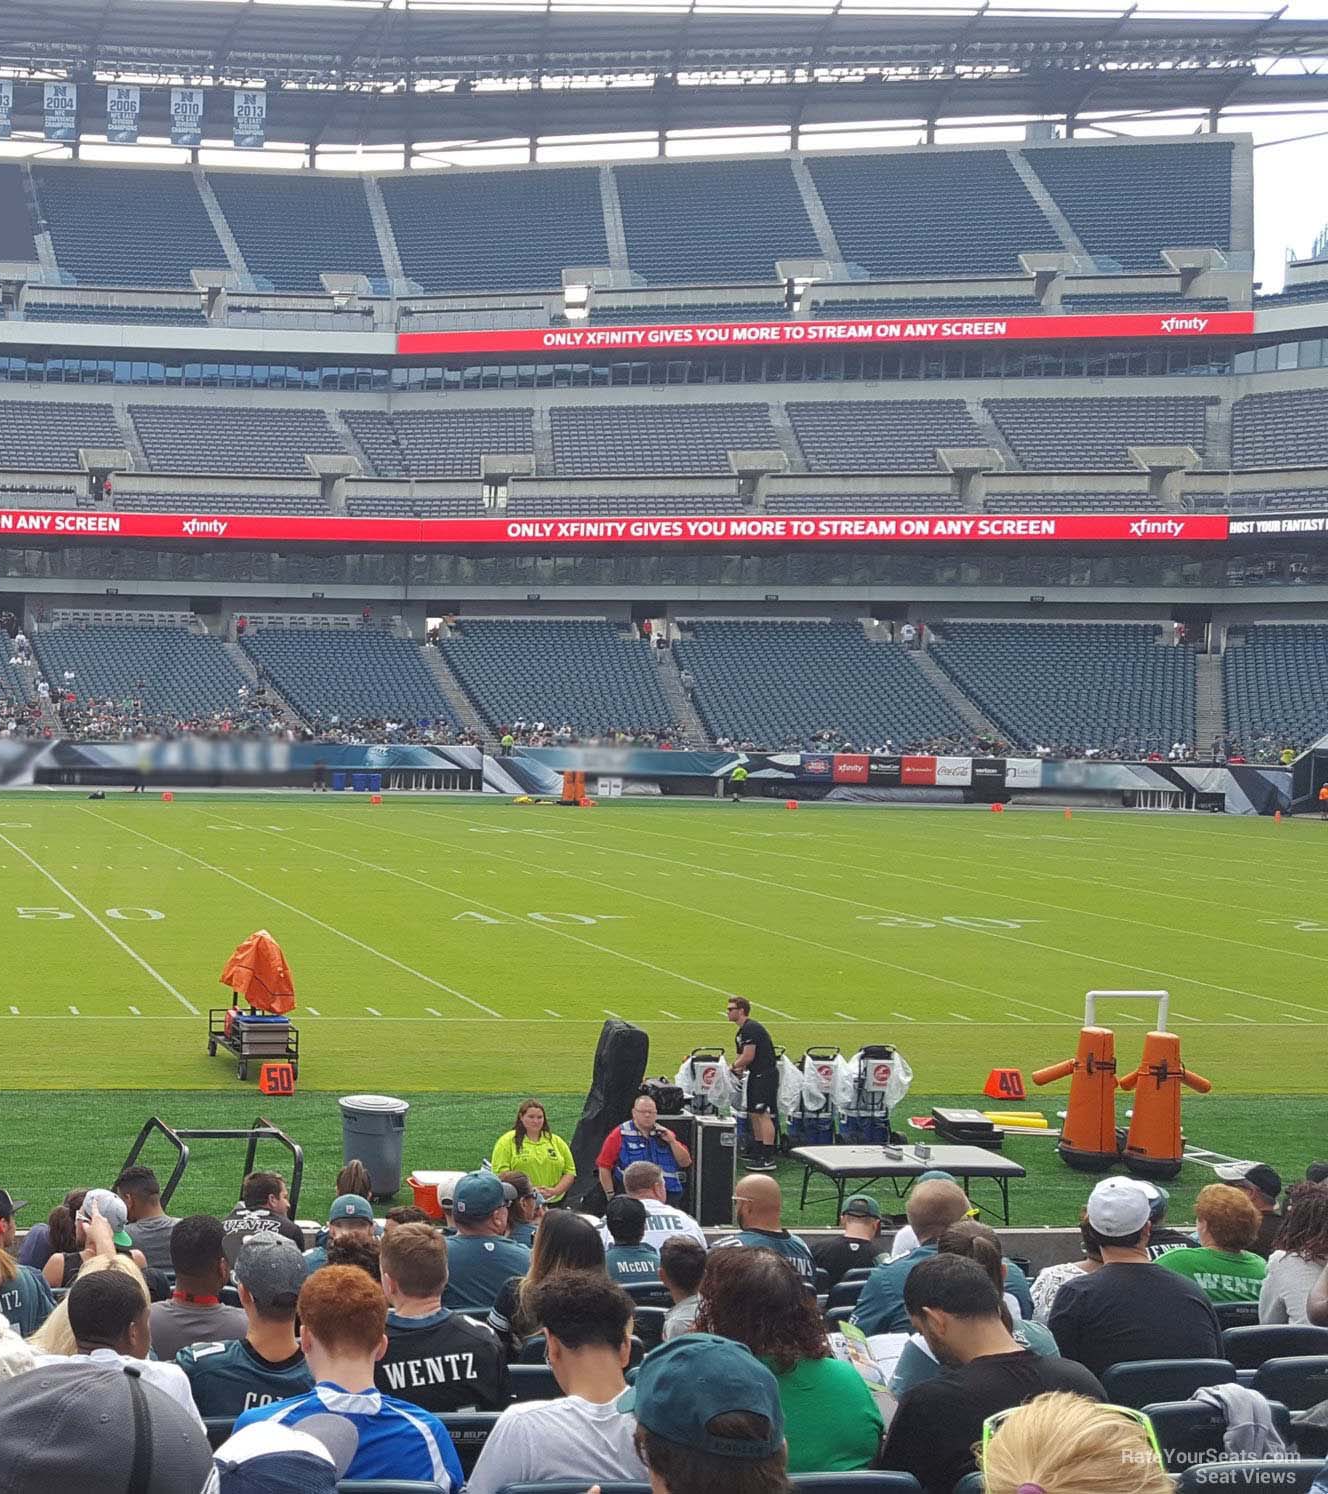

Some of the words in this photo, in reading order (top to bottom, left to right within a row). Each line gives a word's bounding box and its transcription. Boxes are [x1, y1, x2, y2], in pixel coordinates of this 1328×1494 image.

[46, 97, 73, 109] 2004
[110, 100, 137, 111] 2006
[175, 103, 199, 114] 2010
[237, 106, 263, 116] 2013
[1160, 317, 1208, 333] xfinity
[543, 333, 584, 347] ONLY
[586, 331, 645, 345] XFINITY
[648, 330, 692, 343] GIVES
[696, 328, 729, 341] YOU
[733, 327, 780, 340] MORE
[783, 326, 805, 339] TO
[808, 325, 872, 339] STREAM
[876, 324, 900, 337] ON
[904, 323, 939, 337] ANY
[942, 322, 1007, 336] SCREEN
[16, 516, 51, 531] ANY
[55, 516, 120, 532] SCREEN
[182, 518, 228, 535] xfinity
[507, 522, 554, 538] ONLY
[557, 522, 625, 538] XFINITY
[630, 521, 683, 537] GIVES
[686, 520, 726, 536] YOU
[730, 520, 786, 536] MORE
[790, 520, 815, 535] TO
[819, 520, 896, 536] STREAM
[900, 520, 929, 536] ON
[933, 520, 974, 536] ANY
[977, 520, 1055, 536] SCREEN
[1129, 519, 1184, 537] xfinity
[1229, 521, 1254, 534] HOST
[1256, 520, 1280, 533] YOUR
[1282, 518, 1324, 532] FANTASY
[838, 763, 864, 773] xfinity
[266, 1067, 292, 1092] 50
[999, 1071, 1024, 1096] 40
[617, 1261, 656, 1273] McCOY
[383, 1352, 478, 1390] WENTZ
